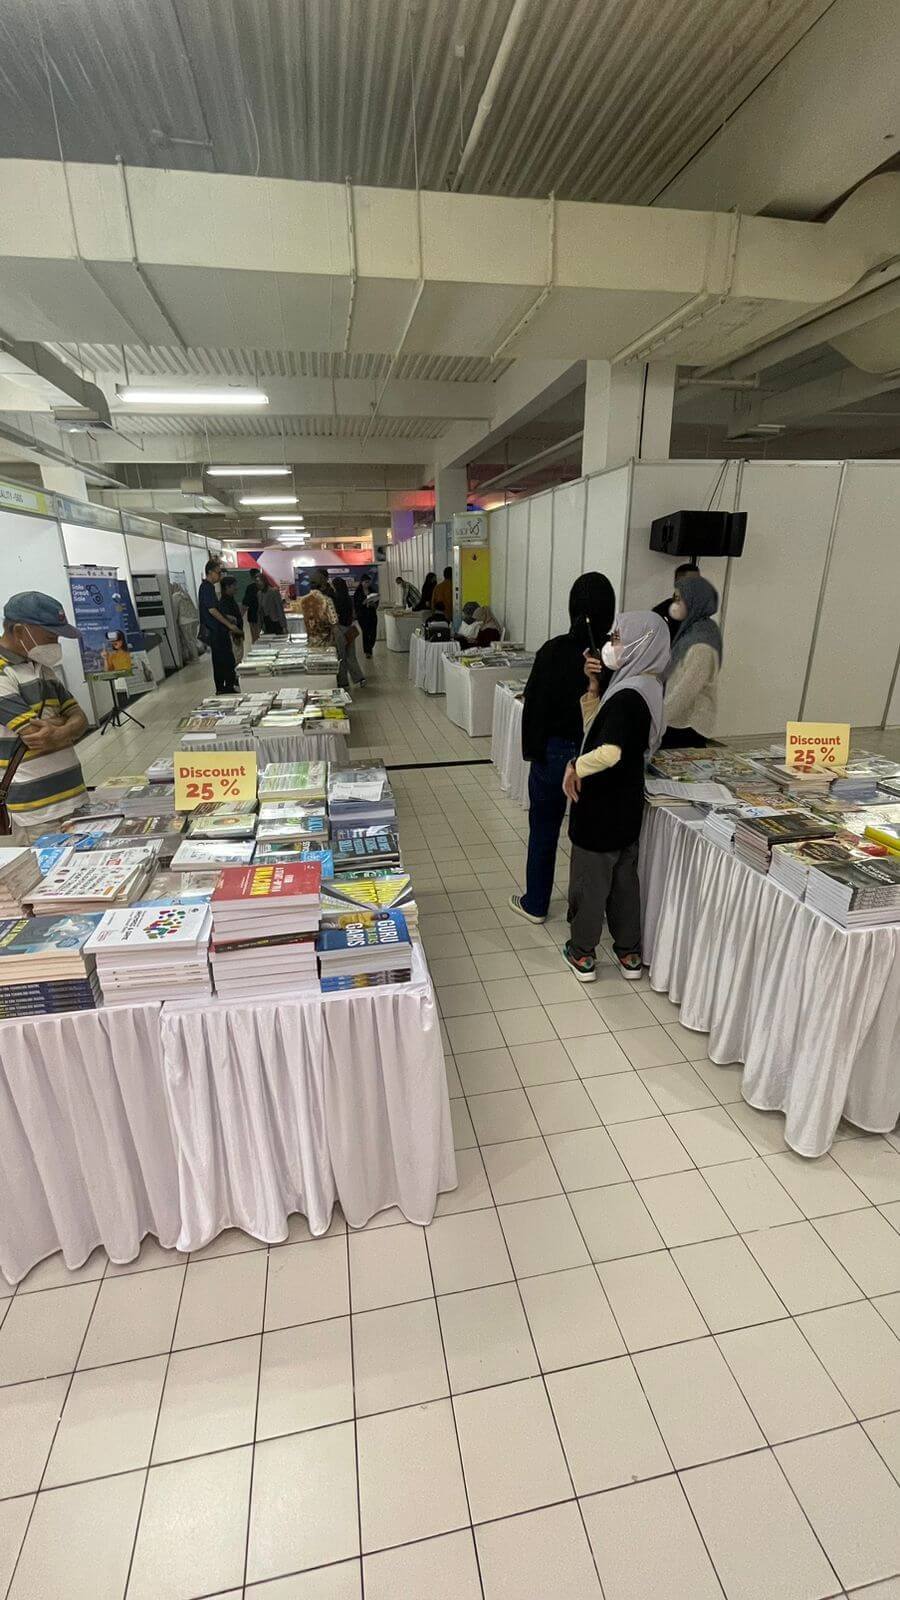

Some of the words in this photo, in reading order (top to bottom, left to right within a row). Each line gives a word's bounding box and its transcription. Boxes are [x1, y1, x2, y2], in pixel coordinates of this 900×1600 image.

[790, 735, 841, 745] Discount
[794, 749, 816, 765] 25
[820, 746, 835, 762] %
[179, 766, 246, 778] Discount
[186, 783, 214, 800] 25
[220, 779, 240, 796] %
[345, 923, 366, 947] GARIS
[377, 920, 399, 943] GURU
